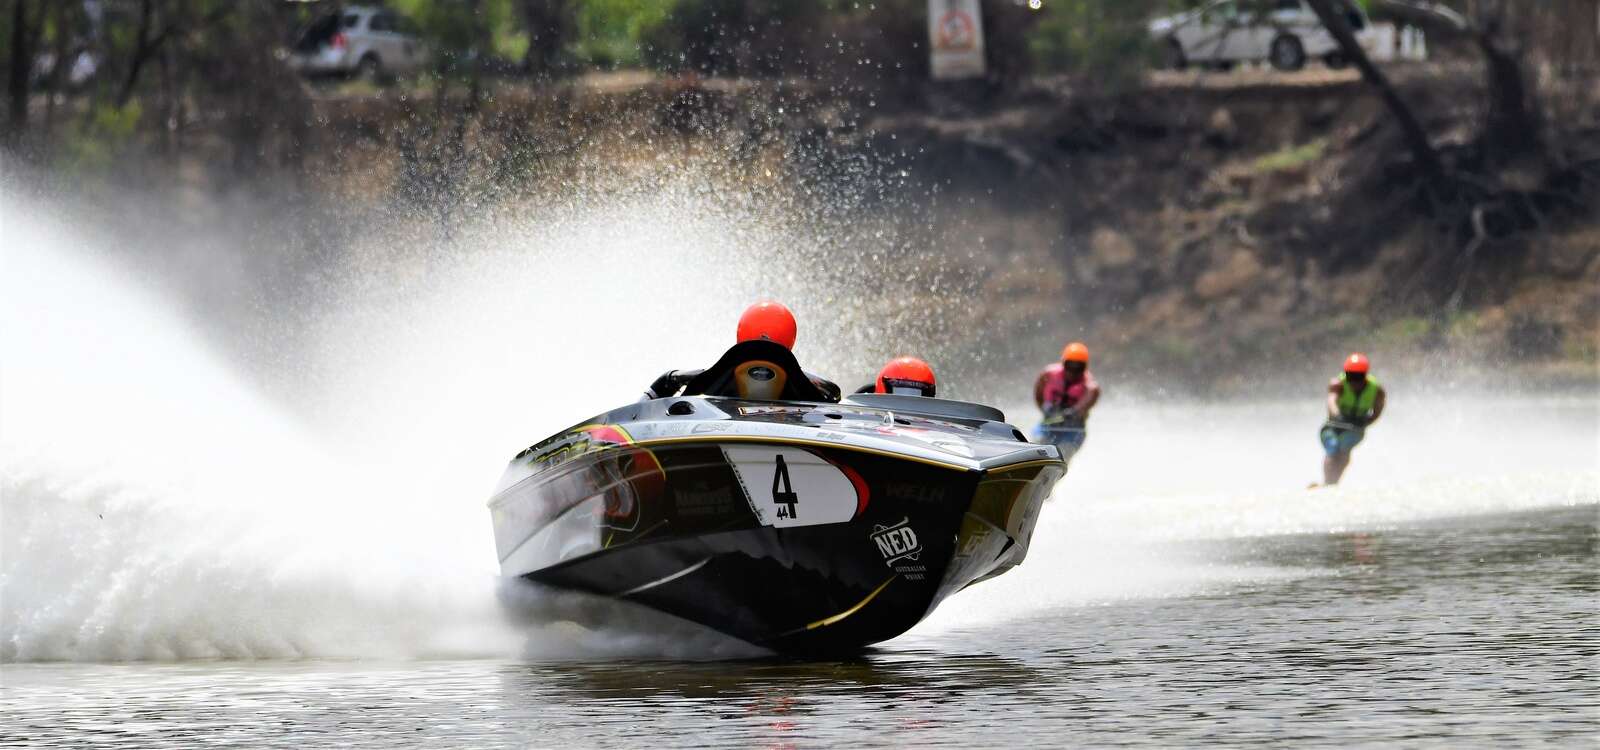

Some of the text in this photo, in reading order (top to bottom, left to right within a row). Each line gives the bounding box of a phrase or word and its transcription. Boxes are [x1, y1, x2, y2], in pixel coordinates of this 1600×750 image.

[772, 454, 798, 519] 4
[776, 505, 789, 520] 44
[874, 526, 918, 558] NED
